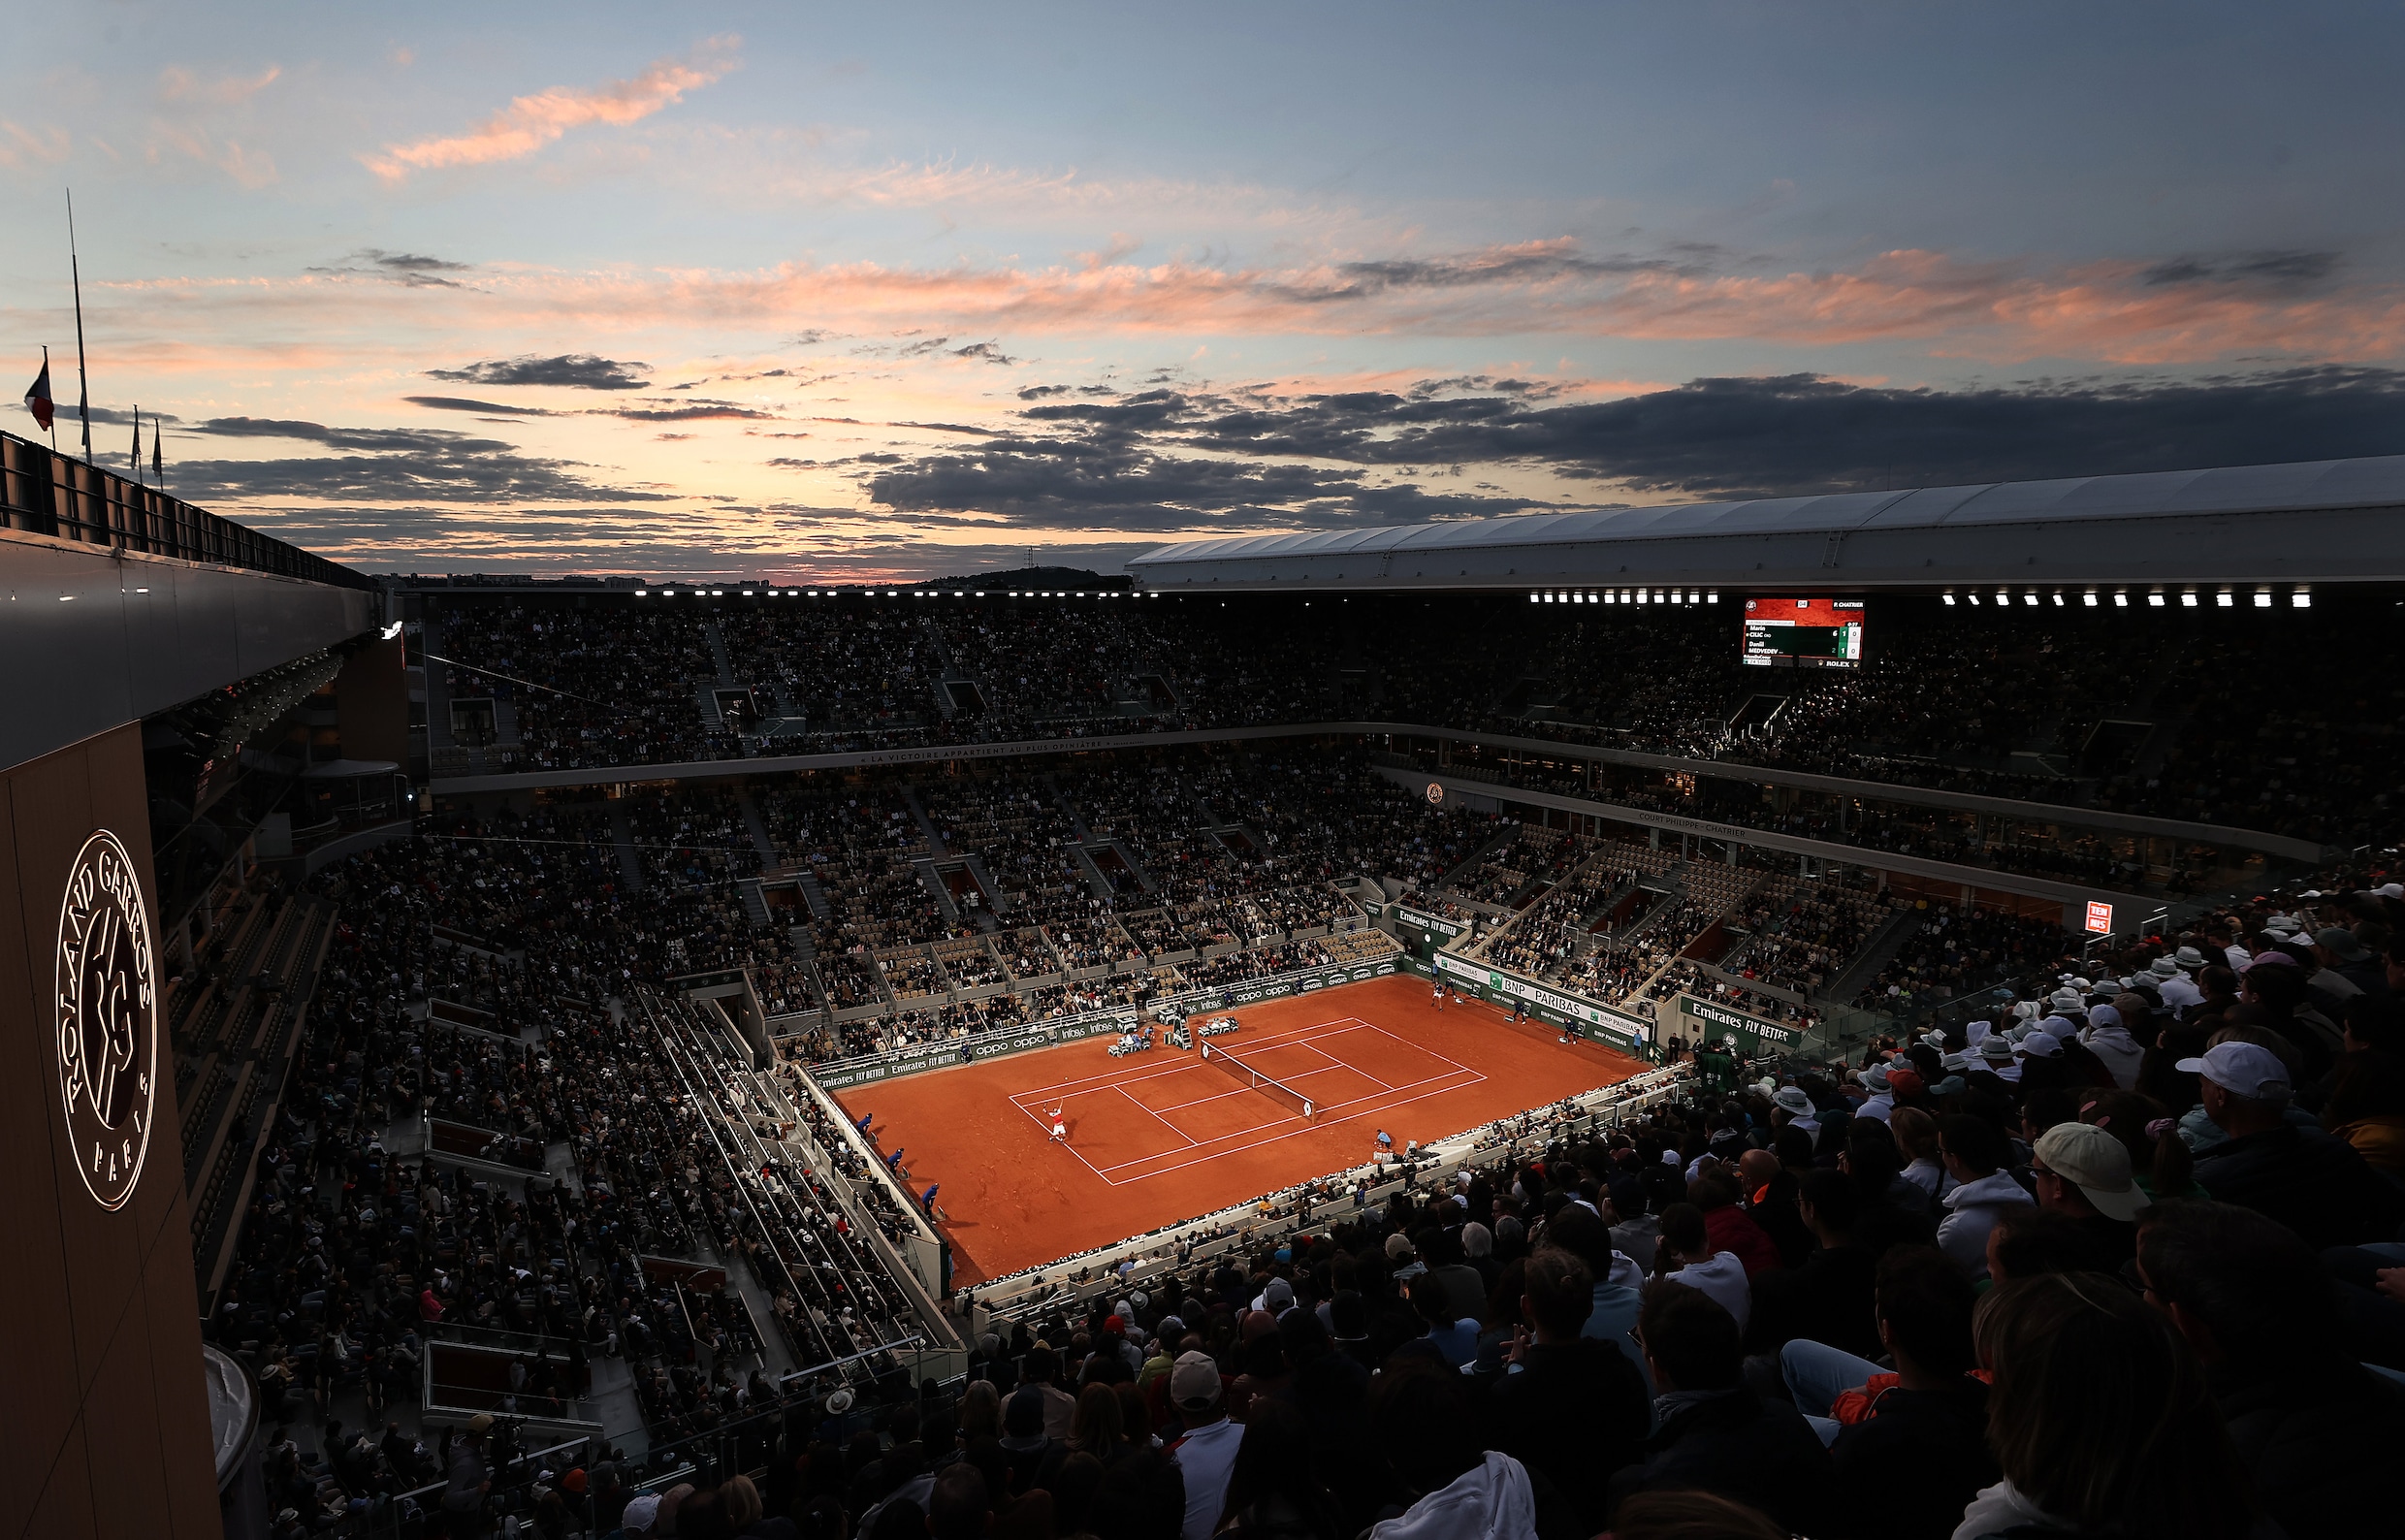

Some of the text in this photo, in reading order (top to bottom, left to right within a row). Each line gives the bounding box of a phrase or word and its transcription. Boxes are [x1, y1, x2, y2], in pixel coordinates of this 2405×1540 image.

[889, 753, 939, 761] VICTOIRE
[944, 748, 1005, 757] APPARTIENT
[1639, 813, 1664, 823] COURT
[1666, 817, 1699, 829] PHILIPPE
[1705, 824, 1746, 838] CHATRIER
[2091, 906, 2108, 916] TEN
[1399, 910, 1458, 937] Emirates FLY BETTER
[2089, 918, 2106, 929] NIS
[1416, 963, 1432, 974] oppo
[1459, 964, 1478, 977] PARIBAS
[60, 850, 151, 1114] ROLAND GARROS
[1236, 990, 1262, 1003] oppo
[1266, 984, 1291, 996] oppo
[1505, 979, 1525, 995] BNP
[1535, 990, 1580, 1015] PARIBAS
[1200, 999, 1222, 1011] Infosys
[1089, 1021, 1113, 1034] Infosys
[1599, 1014, 1613, 1023] BNP
[1613, 1018, 1638, 1033] PARIBAS
[1692, 1002, 1789, 1043] Emirates FLY BETTER
[1062, 1027, 1086, 1039] Infosys
[1593, 1030, 1627, 1046] BNP PARIBAS
[1012, 1035, 1045, 1047] oppo
[976, 1042, 1009, 1055] oppo
[891, 1053, 956, 1075] Emirates FLY BETTER
[856, 1071, 867, 1081] FLY
[866, 1068, 885, 1079] BETTER
